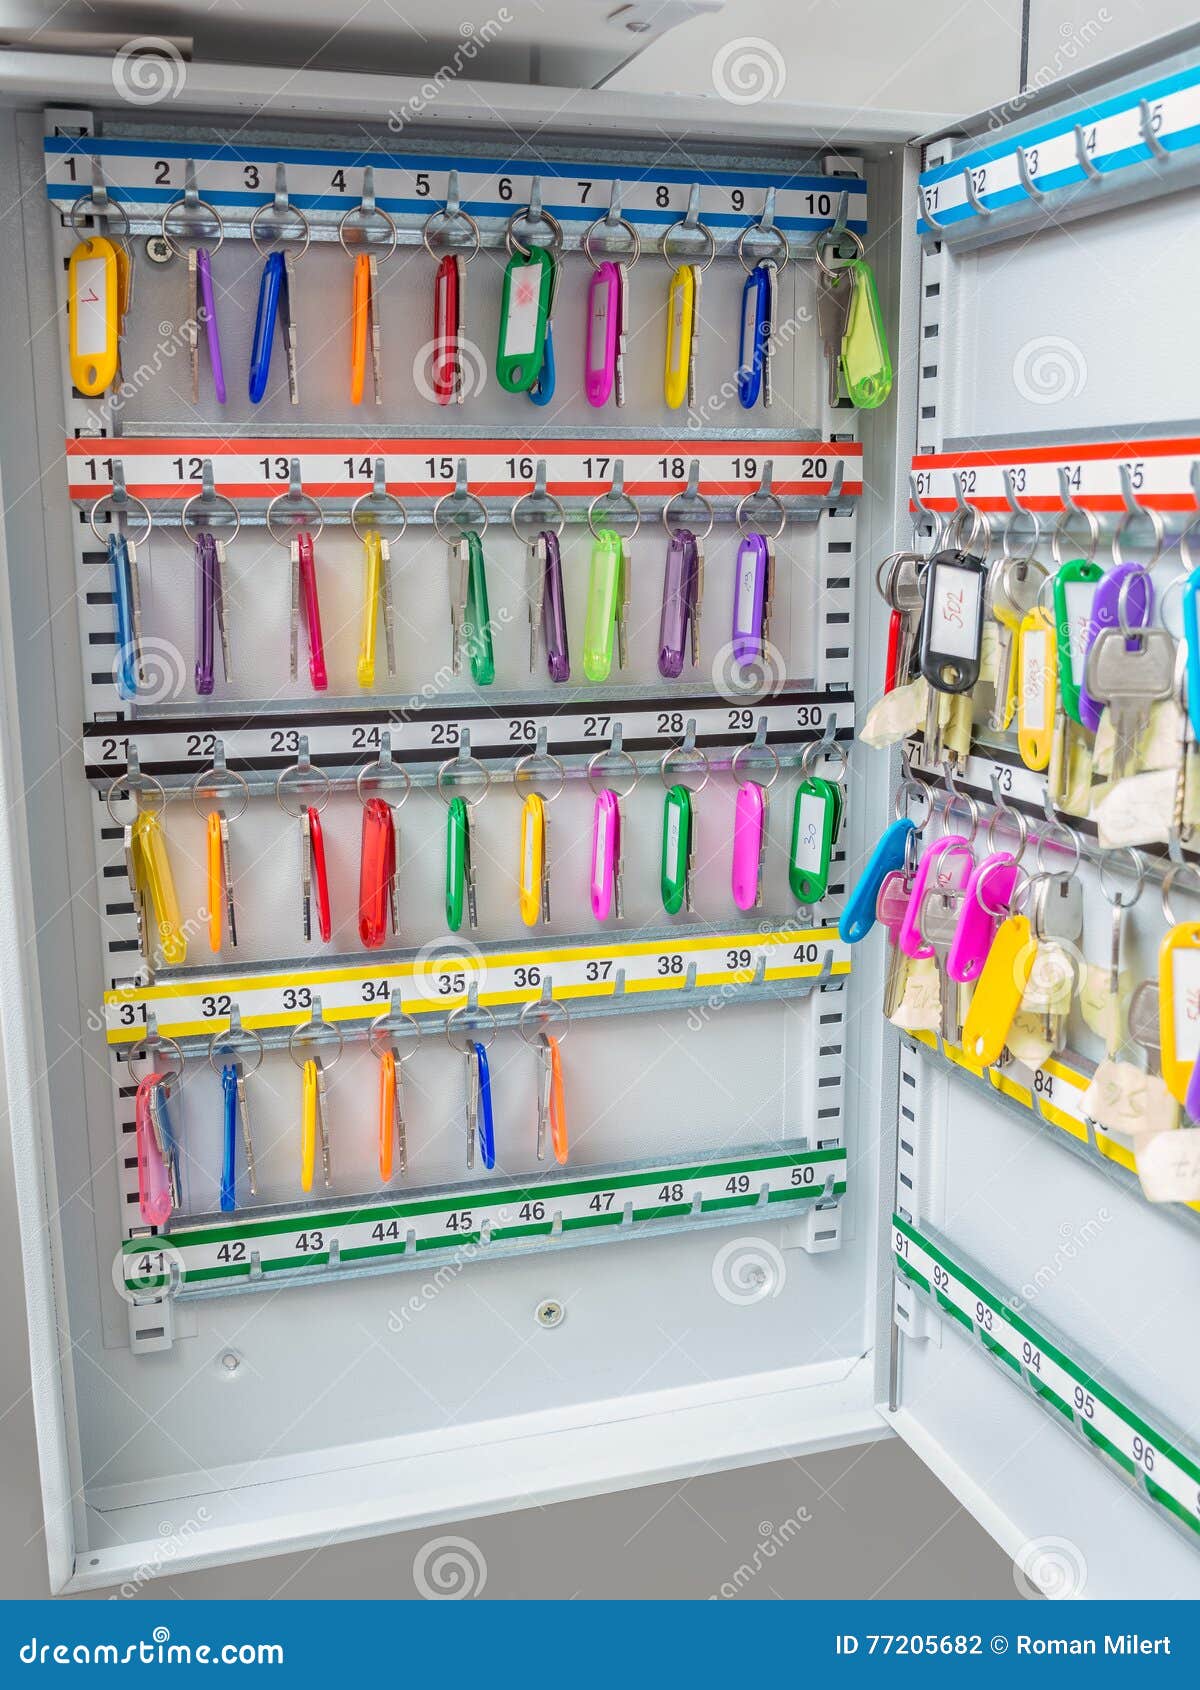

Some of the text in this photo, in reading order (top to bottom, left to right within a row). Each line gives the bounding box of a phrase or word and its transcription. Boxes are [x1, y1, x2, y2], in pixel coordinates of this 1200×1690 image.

[1024, 149, 1039, 175] 3
[1082, 127, 1097, 155] 4
[1150, 104, 1164, 133] 5
[63, 157, 832, 217] 1 2 3 4 5 6 7 8 9 10
[85, 457, 827, 481] 11 12 13 14 15 16 17 18 19 20
[917, 472, 931, 494] 61
[1126, 463, 1144, 488] 5
[102, 706, 822, 760] 21 22 23 24 25 26 27 28 29 30
[908, 742, 1012, 791] 71 73
[120, 944, 818, 1025] 31 32 33 34 35 36 37 38 39 40
[1034, 1069, 1053, 1098] 84
[138, 1166, 815, 1274] 41 42 43 44 45 46 47 48 49 50
[895, 1232, 1155, 1472] 91 92 93 94 95 96
